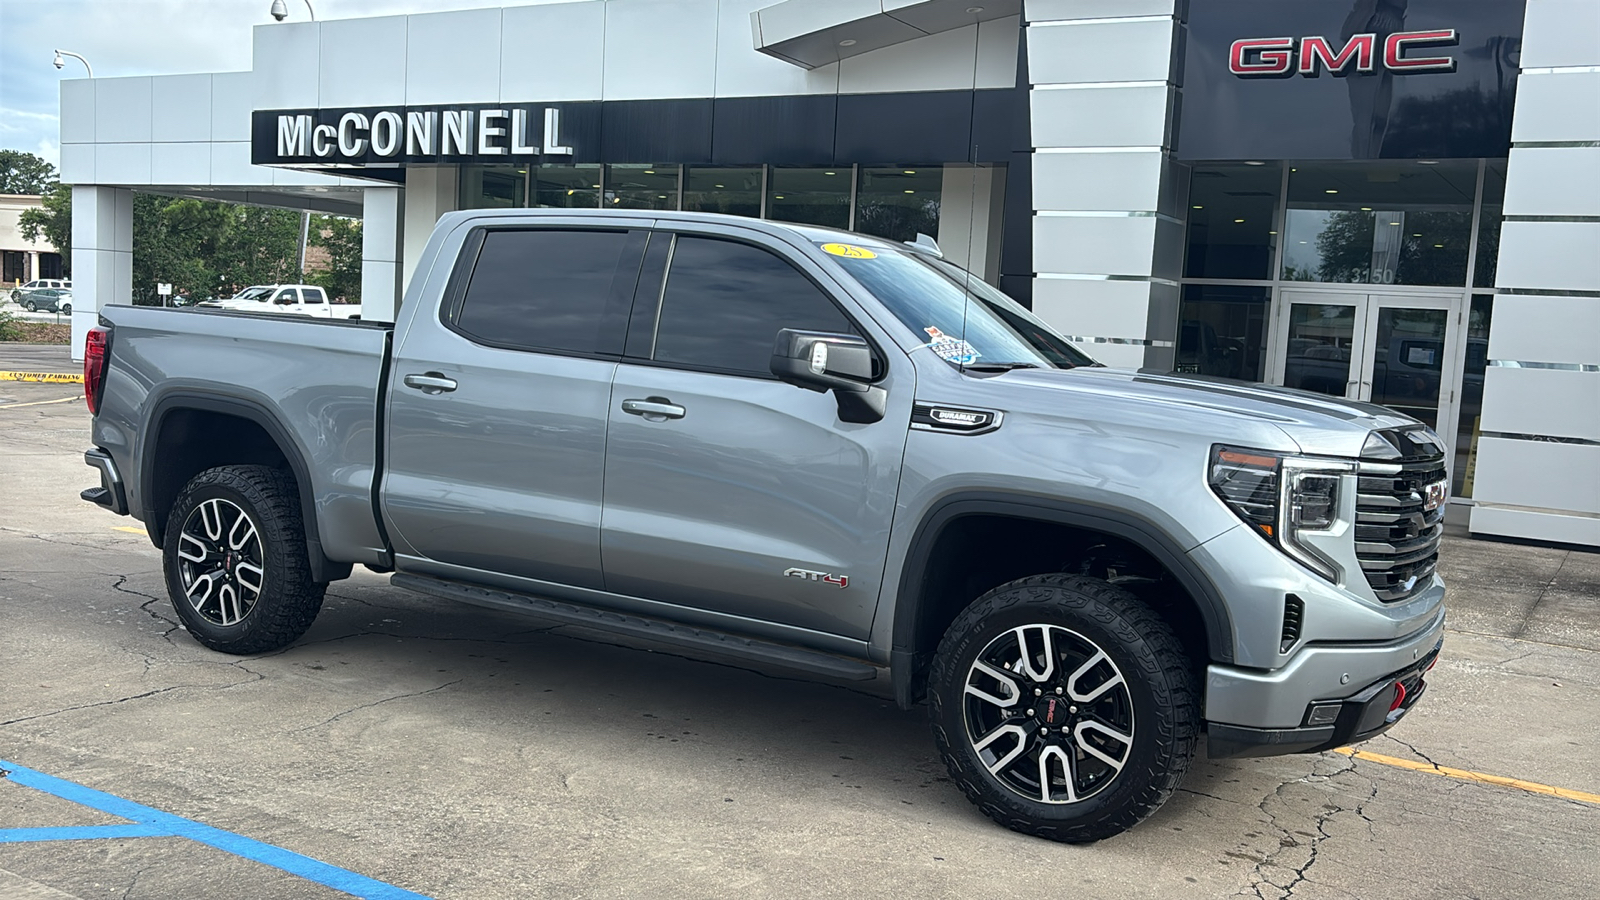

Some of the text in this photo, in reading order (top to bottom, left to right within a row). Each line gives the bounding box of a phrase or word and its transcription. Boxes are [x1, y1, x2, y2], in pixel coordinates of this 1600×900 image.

[1229, 28, 1456, 74] GMC
[277, 107, 573, 157] McCONNELL
[837, 244, 863, 257] 25
[1351, 267, 1393, 284] 3150
[939, 411, 977, 422] DURAMAX
[783, 567, 849, 588] AT4
[1046, 699, 1056, 723] GMC
